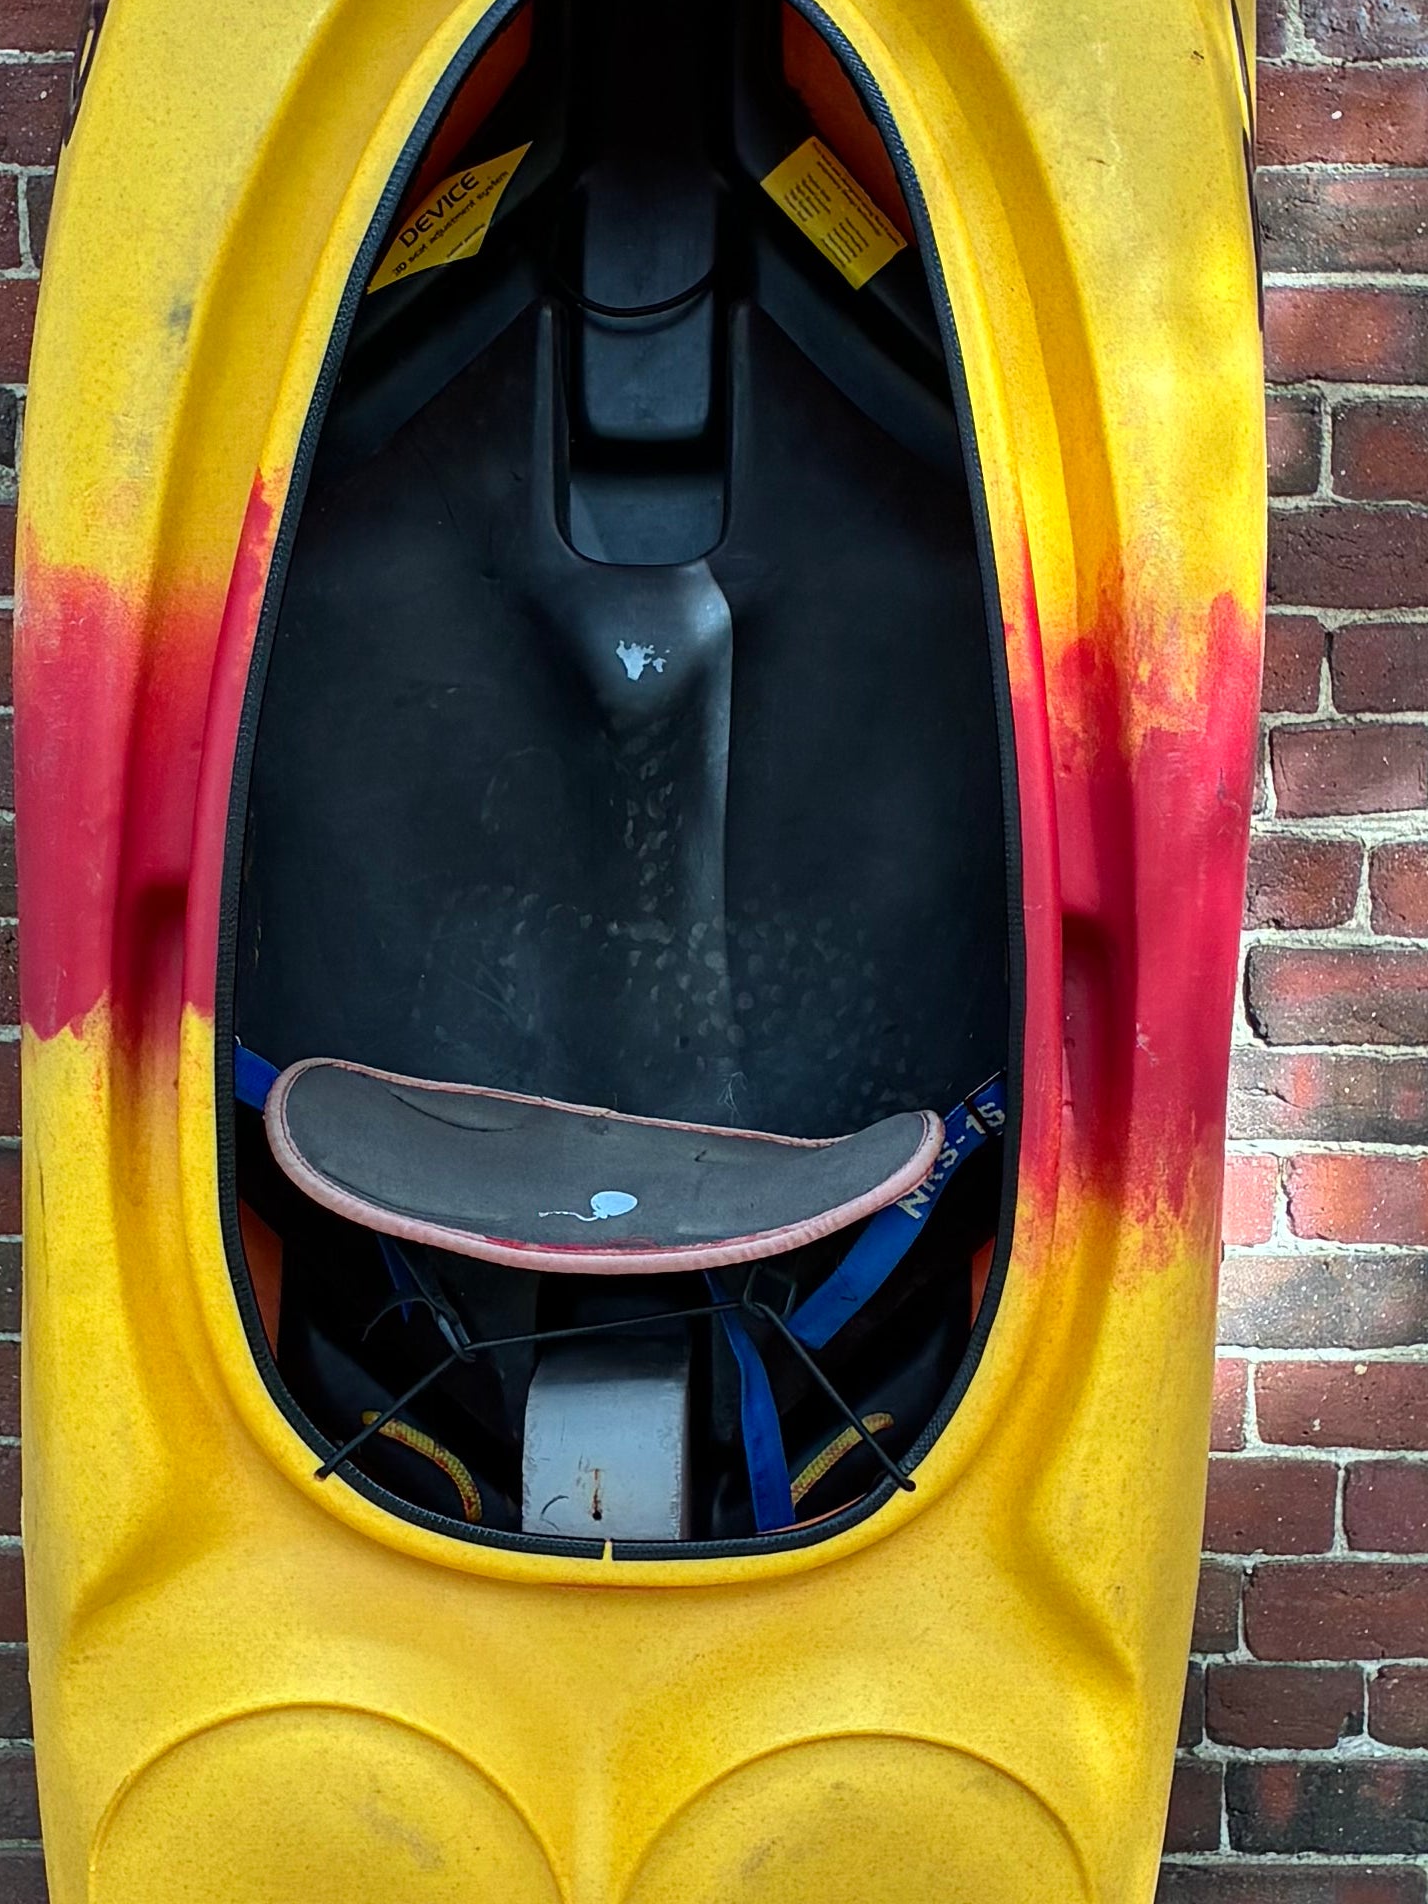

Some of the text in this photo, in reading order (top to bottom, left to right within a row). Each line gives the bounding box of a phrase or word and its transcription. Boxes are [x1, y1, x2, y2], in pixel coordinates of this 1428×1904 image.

[399, 171, 479, 248] DEVICE
[430, 200, 476, 244] adjustment
[477, 171, 508, 200] system
